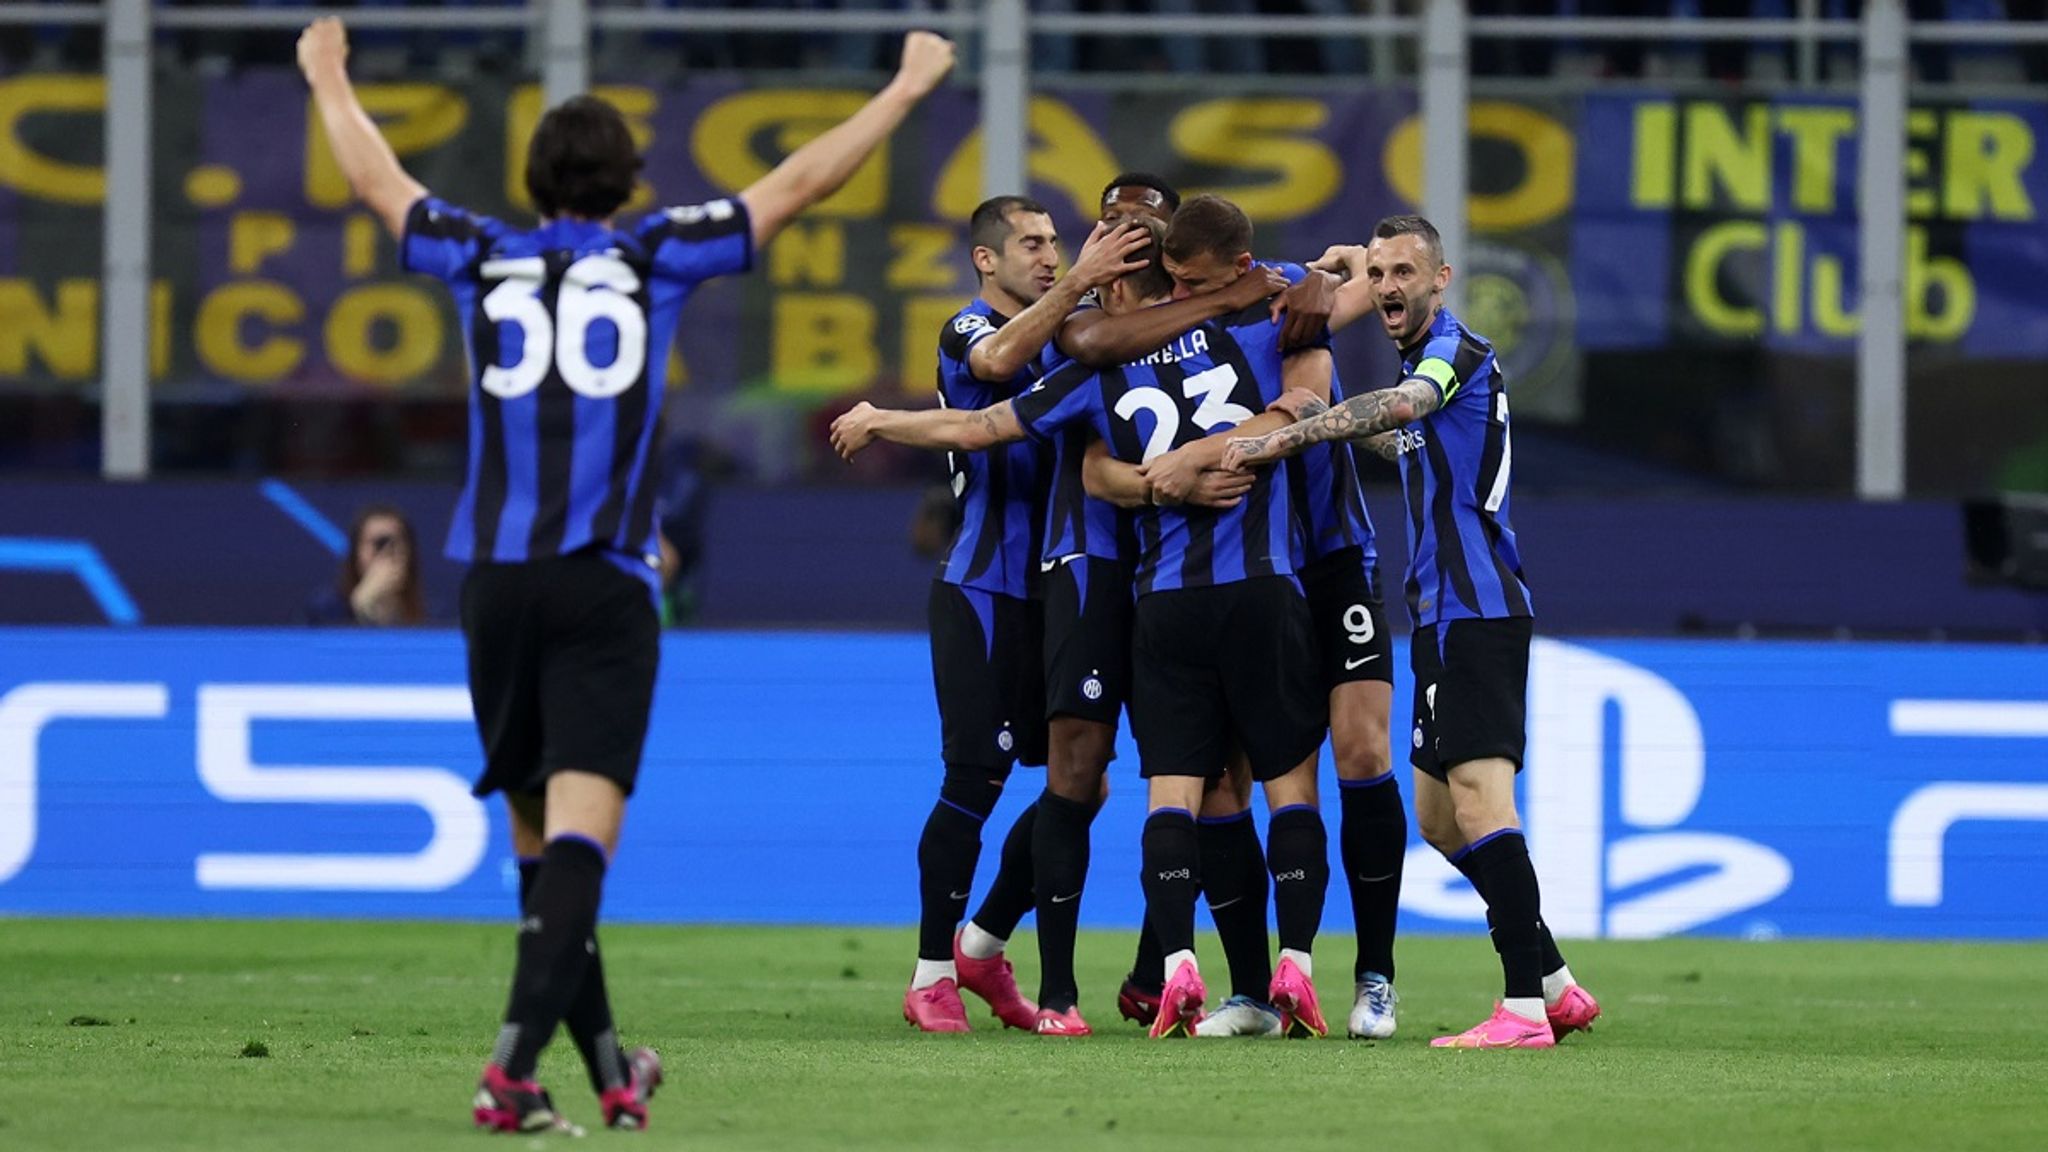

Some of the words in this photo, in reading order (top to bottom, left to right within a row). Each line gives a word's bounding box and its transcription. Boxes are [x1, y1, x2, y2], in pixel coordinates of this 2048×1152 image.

[1633, 103, 2035, 220] INTER
[480, 256, 646, 398] 36
[1685, 220, 1975, 342] Club
[1115, 363, 1254, 464] 23
[1343, 604, 1375, 644] 9
